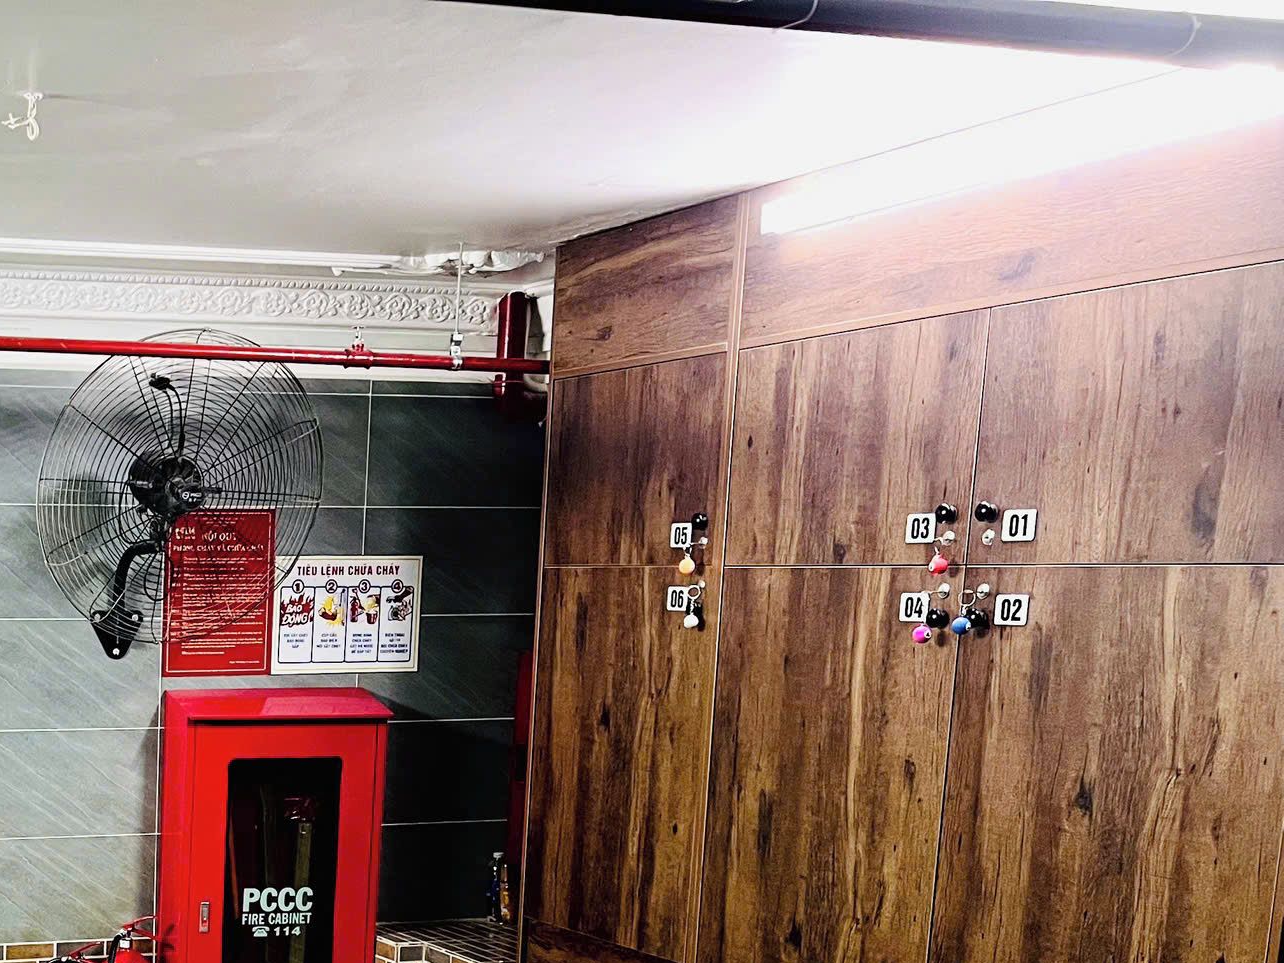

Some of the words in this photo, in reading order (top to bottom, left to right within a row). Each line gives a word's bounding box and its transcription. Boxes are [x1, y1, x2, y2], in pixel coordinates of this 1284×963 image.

[911, 518, 930, 539] 03
[1009, 514, 1028, 537] 01
[674, 527, 688, 545] 05
[297, 564, 317, 576] TIÊU
[321, 564, 344, 578] LỆNH
[348, 563, 373, 576] CHỮA
[376, 563, 401, 576] CHÁY
[295, 583, 300, 591] 1
[328, 582, 335, 591] 2
[361, 582, 368, 590] 3
[394, 582, 401, 590] 4
[671, 590, 685, 608] 06
[904, 597, 923, 618] 04
[1000, 599, 1022, 622] 02
[242, 887, 313, 912] PCCC
[242, 913, 265, 925] FIRE
[268, 912, 312, 925] CABINET
[273, 926, 301, 936] 114
